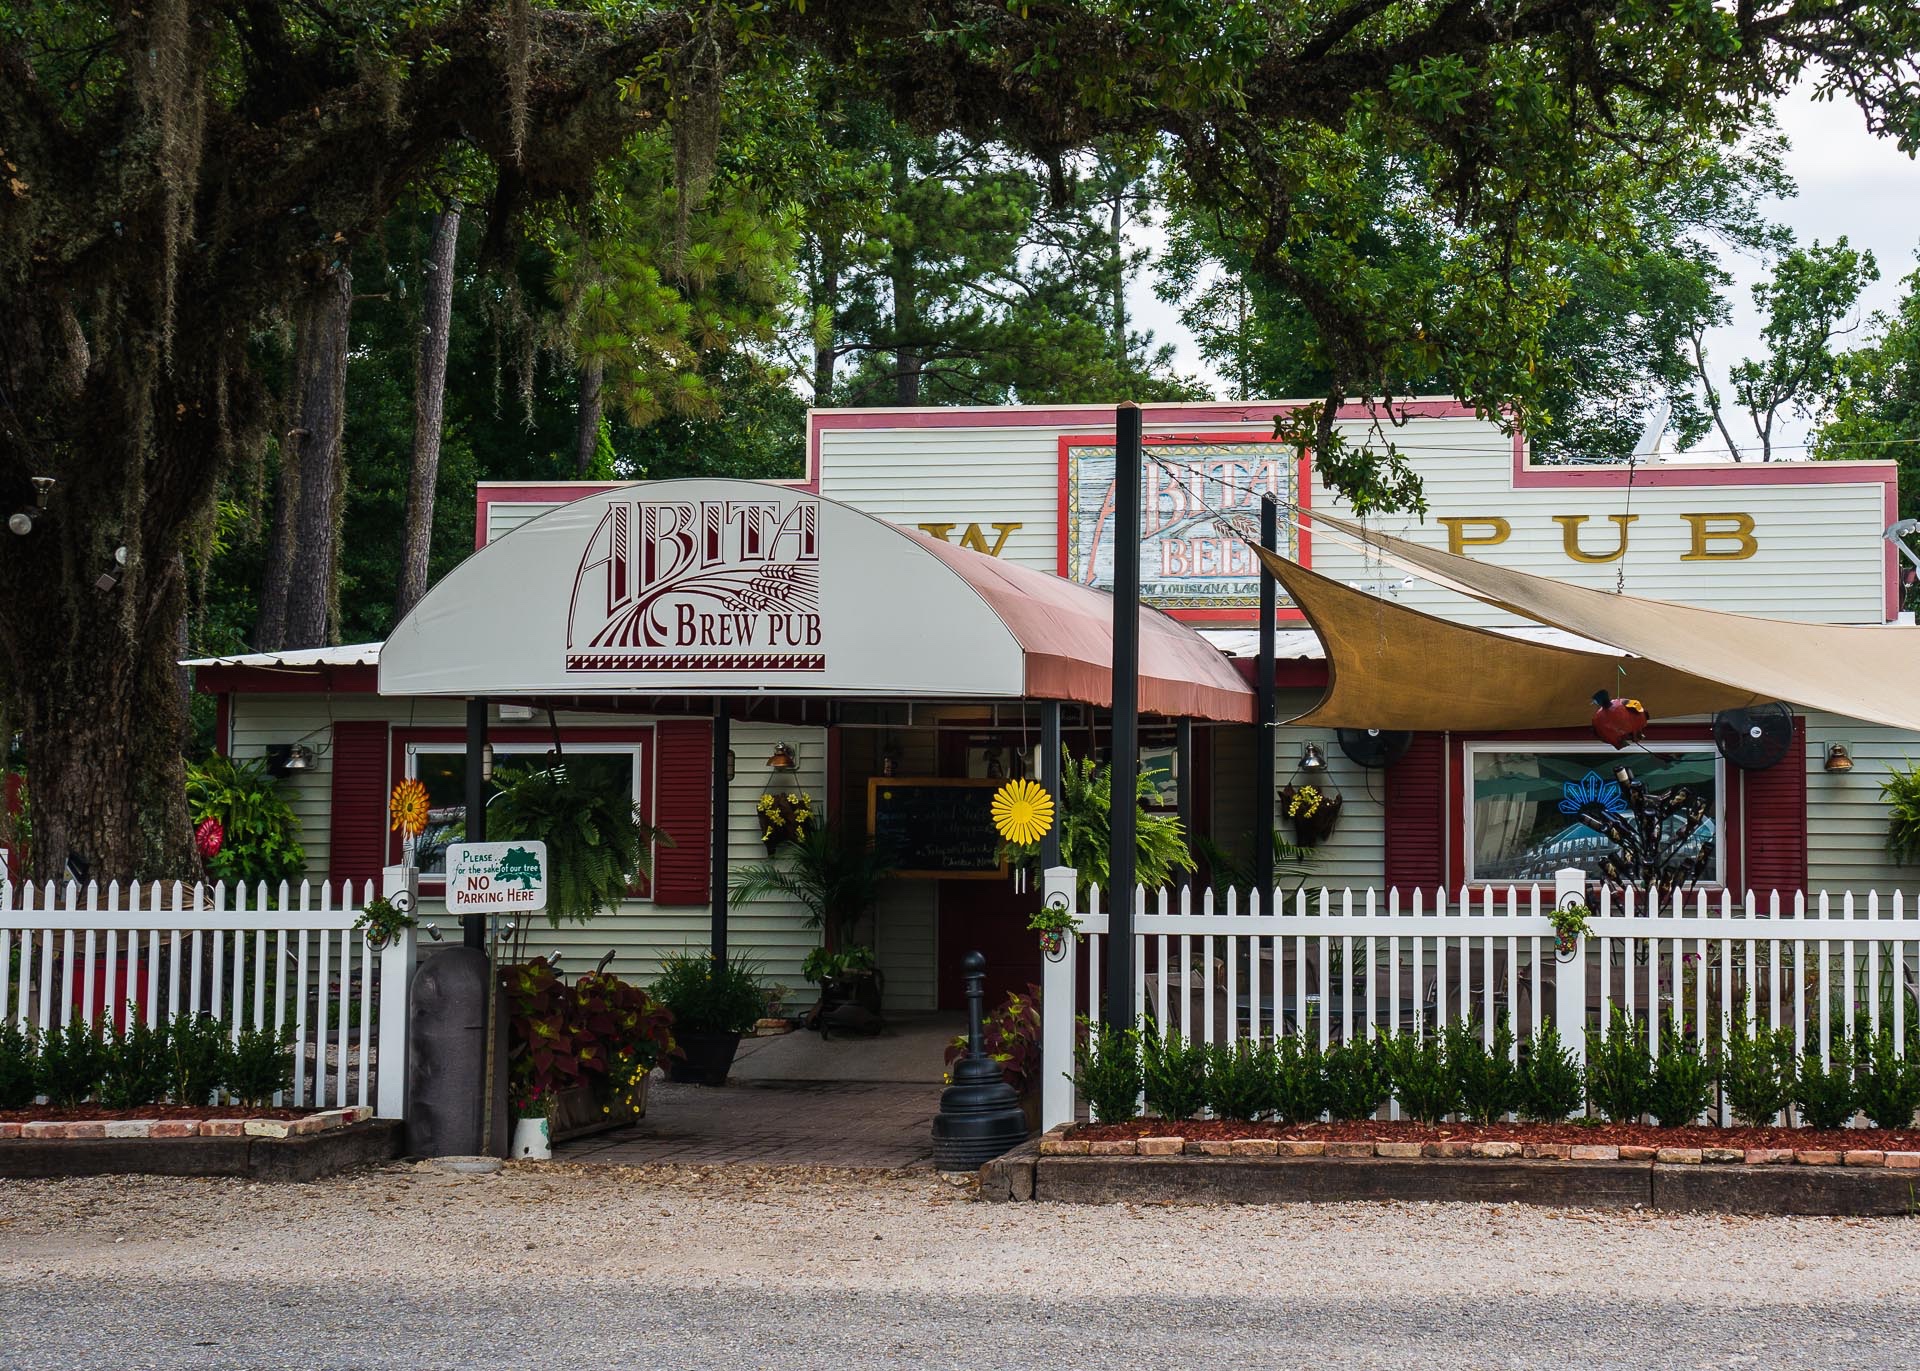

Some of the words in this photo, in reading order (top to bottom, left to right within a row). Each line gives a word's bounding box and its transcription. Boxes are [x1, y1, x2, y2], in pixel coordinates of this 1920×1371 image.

[1437, 513, 1758, 563] PUB
[567, 501, 820, 650] ABITA
[1161, 583, 1229, 595] LOUISIANA
[1234, 583, 1259, 594] LAG
[675, 603, 757, 646] BREW
[768, 613, 822, 646] PUB
[469, 863, 481, 874] the
[483, 864, 500, 874] sake
[501, 864, 509, 873] of
[524, 864, 538, 872] tree
[467, 876, 490, 891] NO
[457, 890, 504, 904] PARKING
[507, 888, 534, 902] HERE
